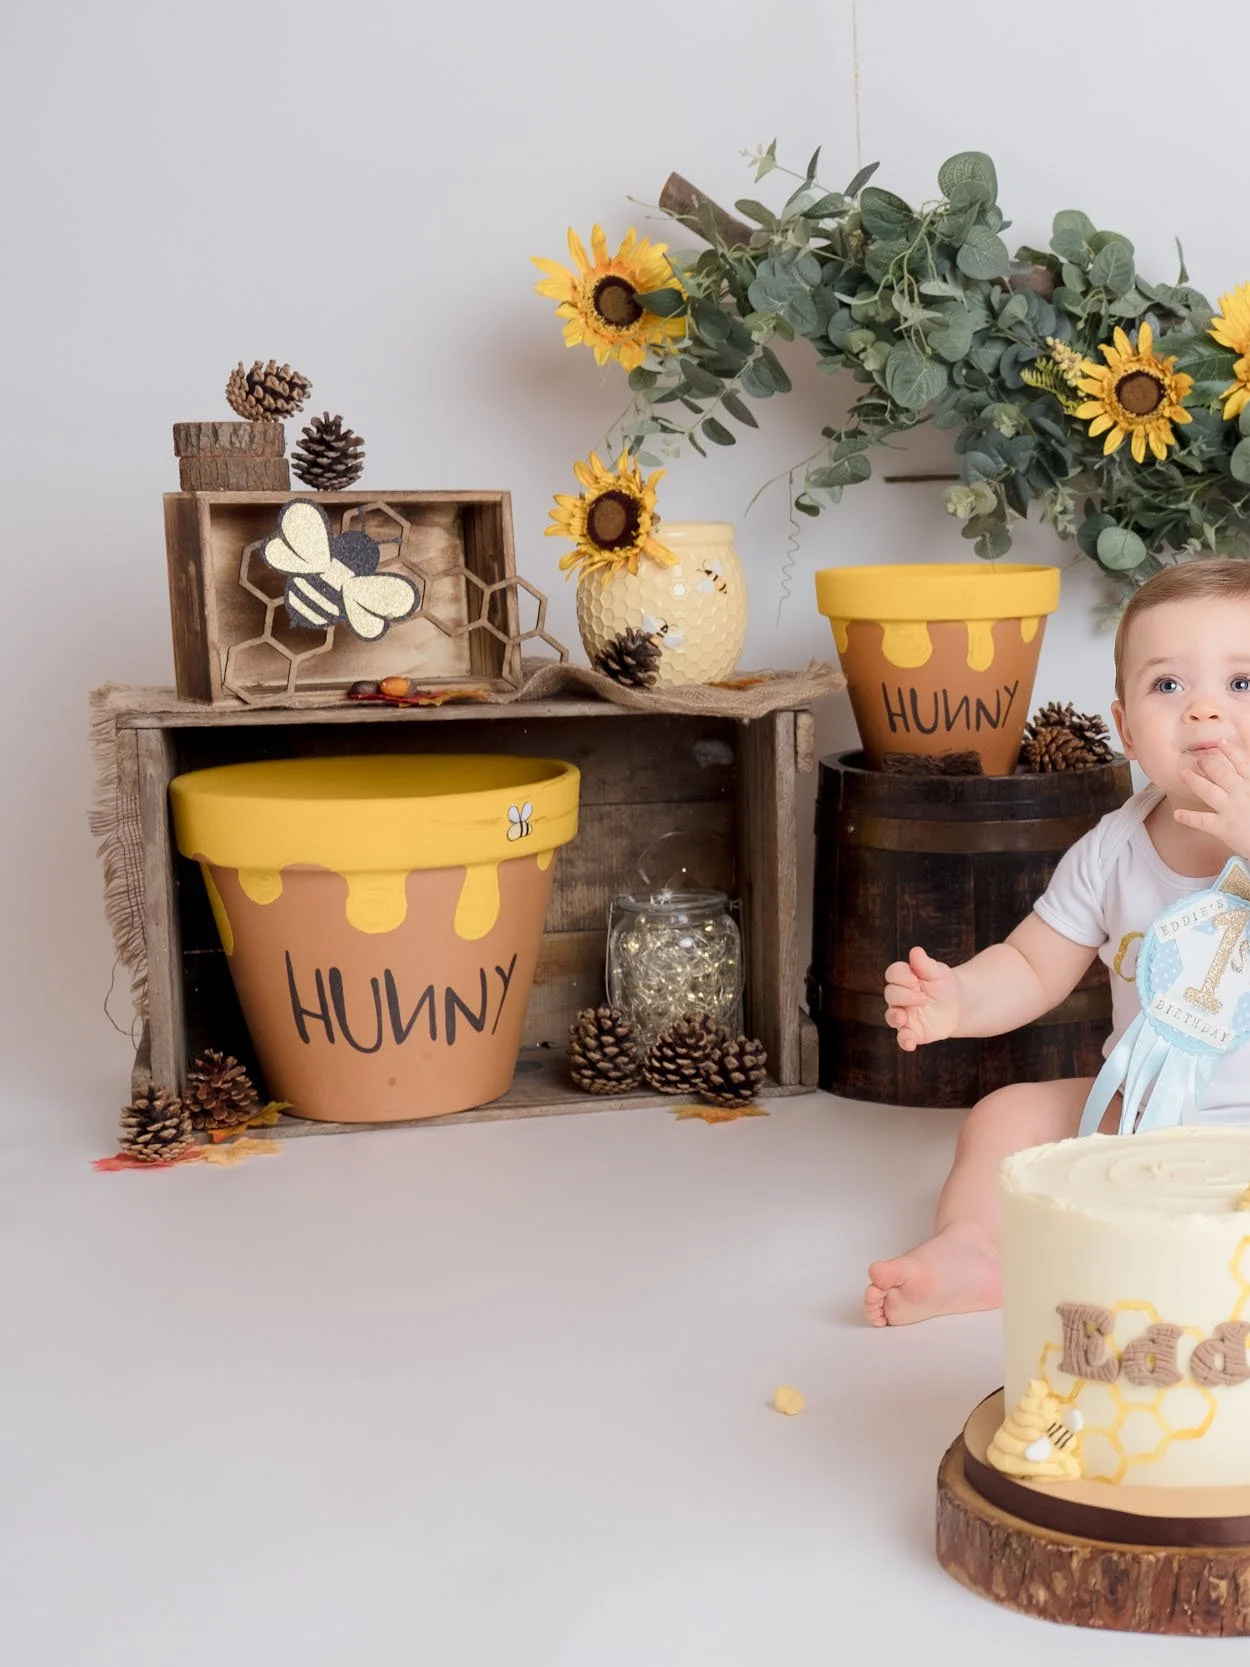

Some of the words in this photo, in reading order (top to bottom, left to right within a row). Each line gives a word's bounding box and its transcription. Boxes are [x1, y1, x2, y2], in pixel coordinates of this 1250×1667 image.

[881, 680, 1019, 734] HUNNY
[1160, 899, 1225, 936] EDDIE'S
[285, 950, 517, 1054] HUNNY
[1154, 999, 1230, 1042] BIRTHDAY
